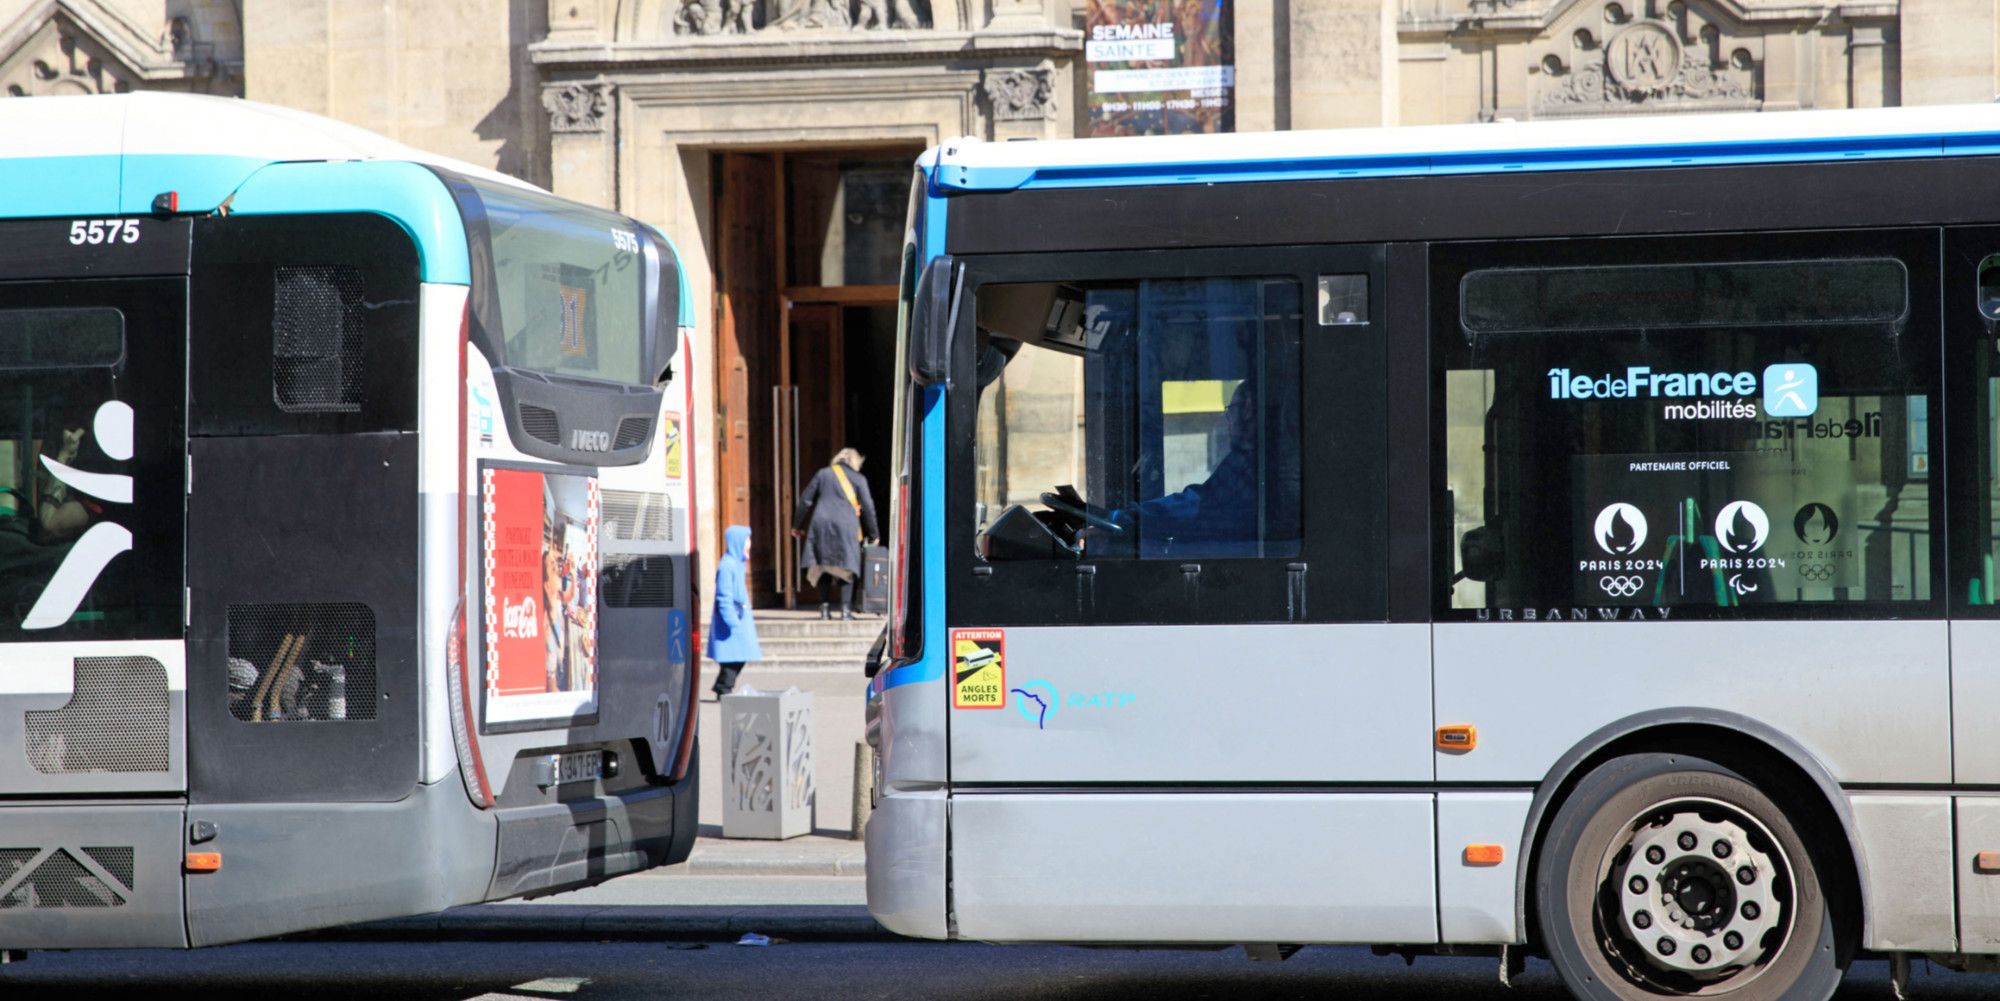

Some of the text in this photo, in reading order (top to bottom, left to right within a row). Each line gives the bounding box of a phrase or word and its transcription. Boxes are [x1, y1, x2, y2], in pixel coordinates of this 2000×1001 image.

[1092, 23, 1174, 40] SEMAINE
[1094, 44, 1156, 57] SAINTE
[69, 219, 140, 245] 5575
[611, 227, 639, 254] 5575
[1664, 400, 1756, 420] mobilités
[571, 430, 610, 452] IVECO
[1630, 461, 1730, 472] PARTENAIRE OFFICIEL
[1580, 560, 1664, 571] PARIS 2024
[1700, 558, 1786, 569] PARIS 2024
[1477, 607, 1671, 621] URBANWAY
[955, 631, 1002, 639] ATTENTION
[961, 685, 998, 694] ANGLES
[963, 694, 996, 702] MORTS
[1067, 692, 1137, 708] RATP
[657, 700, 670, 743] 70
